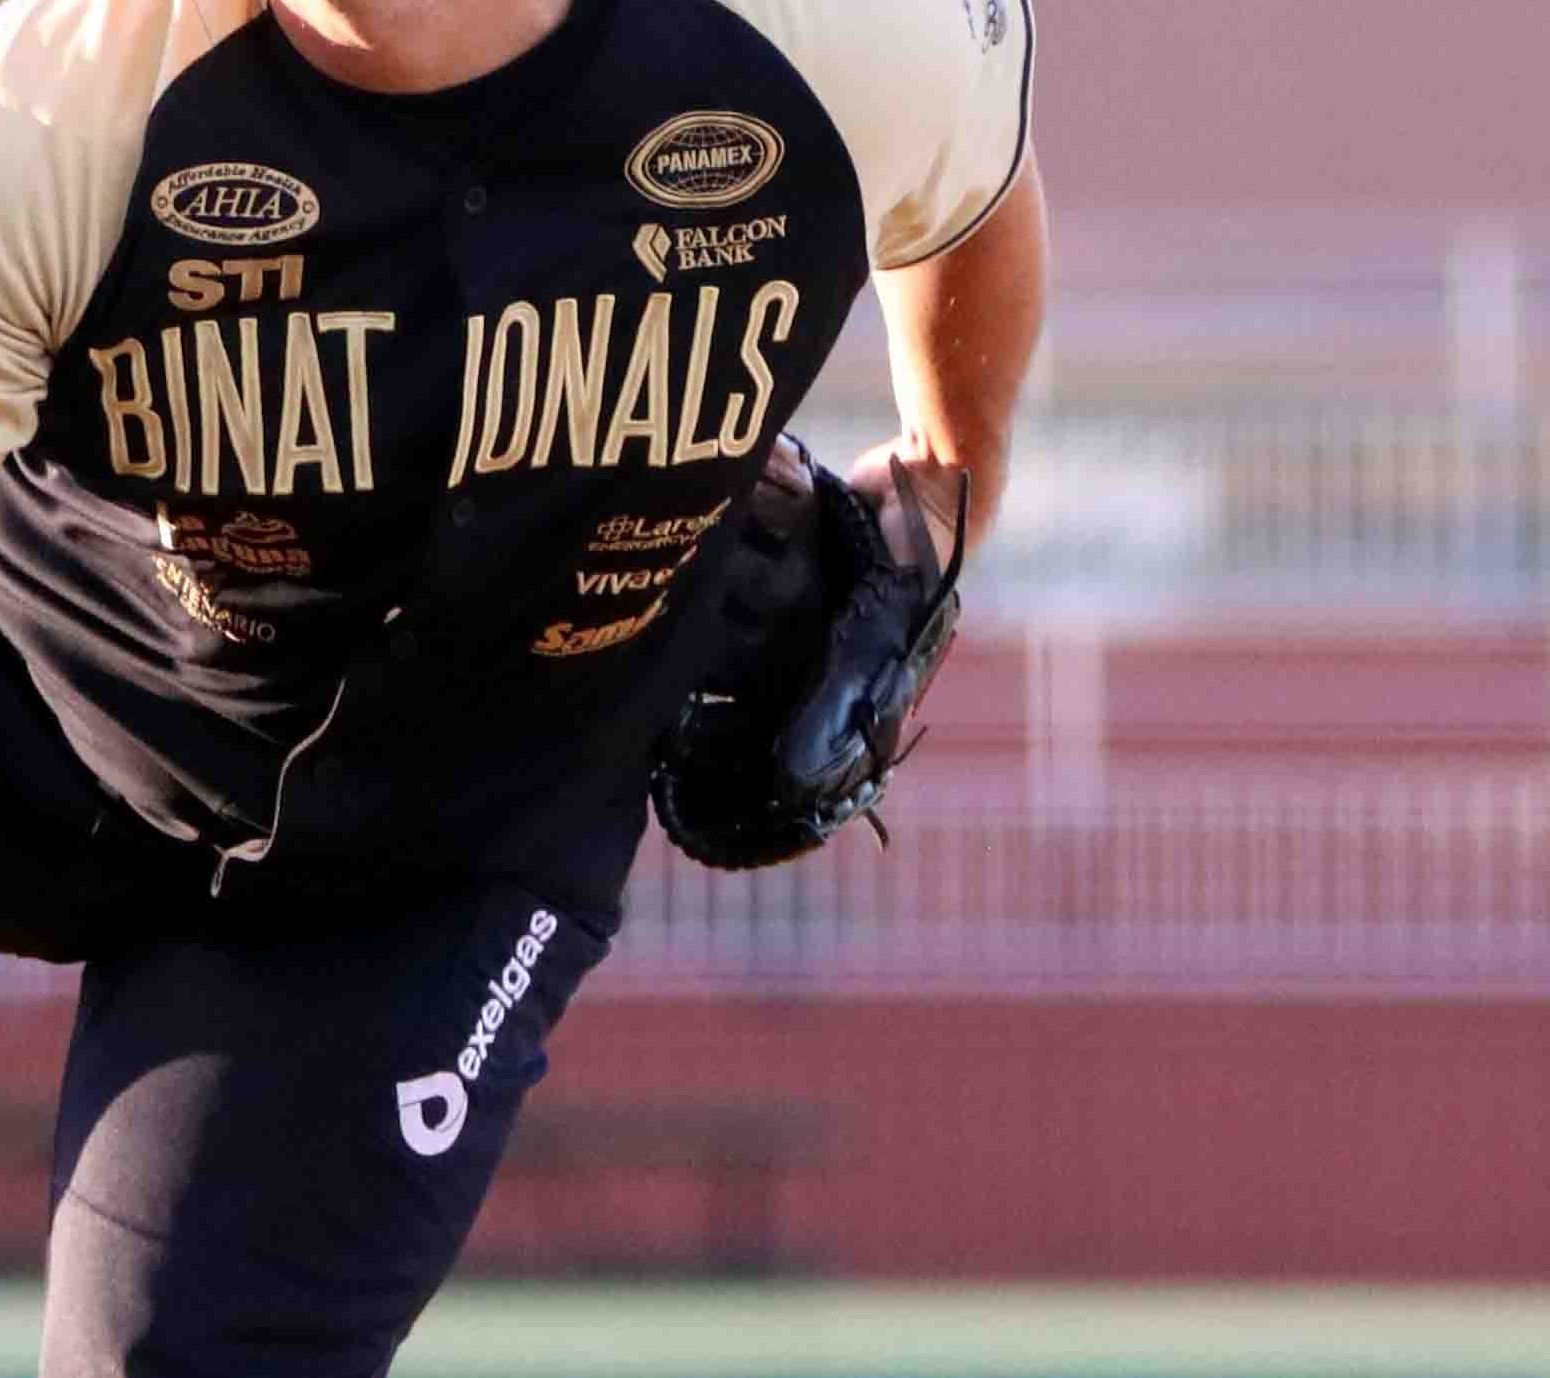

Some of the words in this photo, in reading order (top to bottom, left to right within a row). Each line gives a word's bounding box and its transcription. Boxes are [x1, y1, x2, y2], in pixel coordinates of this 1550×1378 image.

[656, 143, 753, 174] PANAMEX
[186, 186, 282, 219] AHIA
[676, 215, 788, 250] FALCON
[677, 243, 754, 270] BANK
[167, 254, 304, 311] STI
